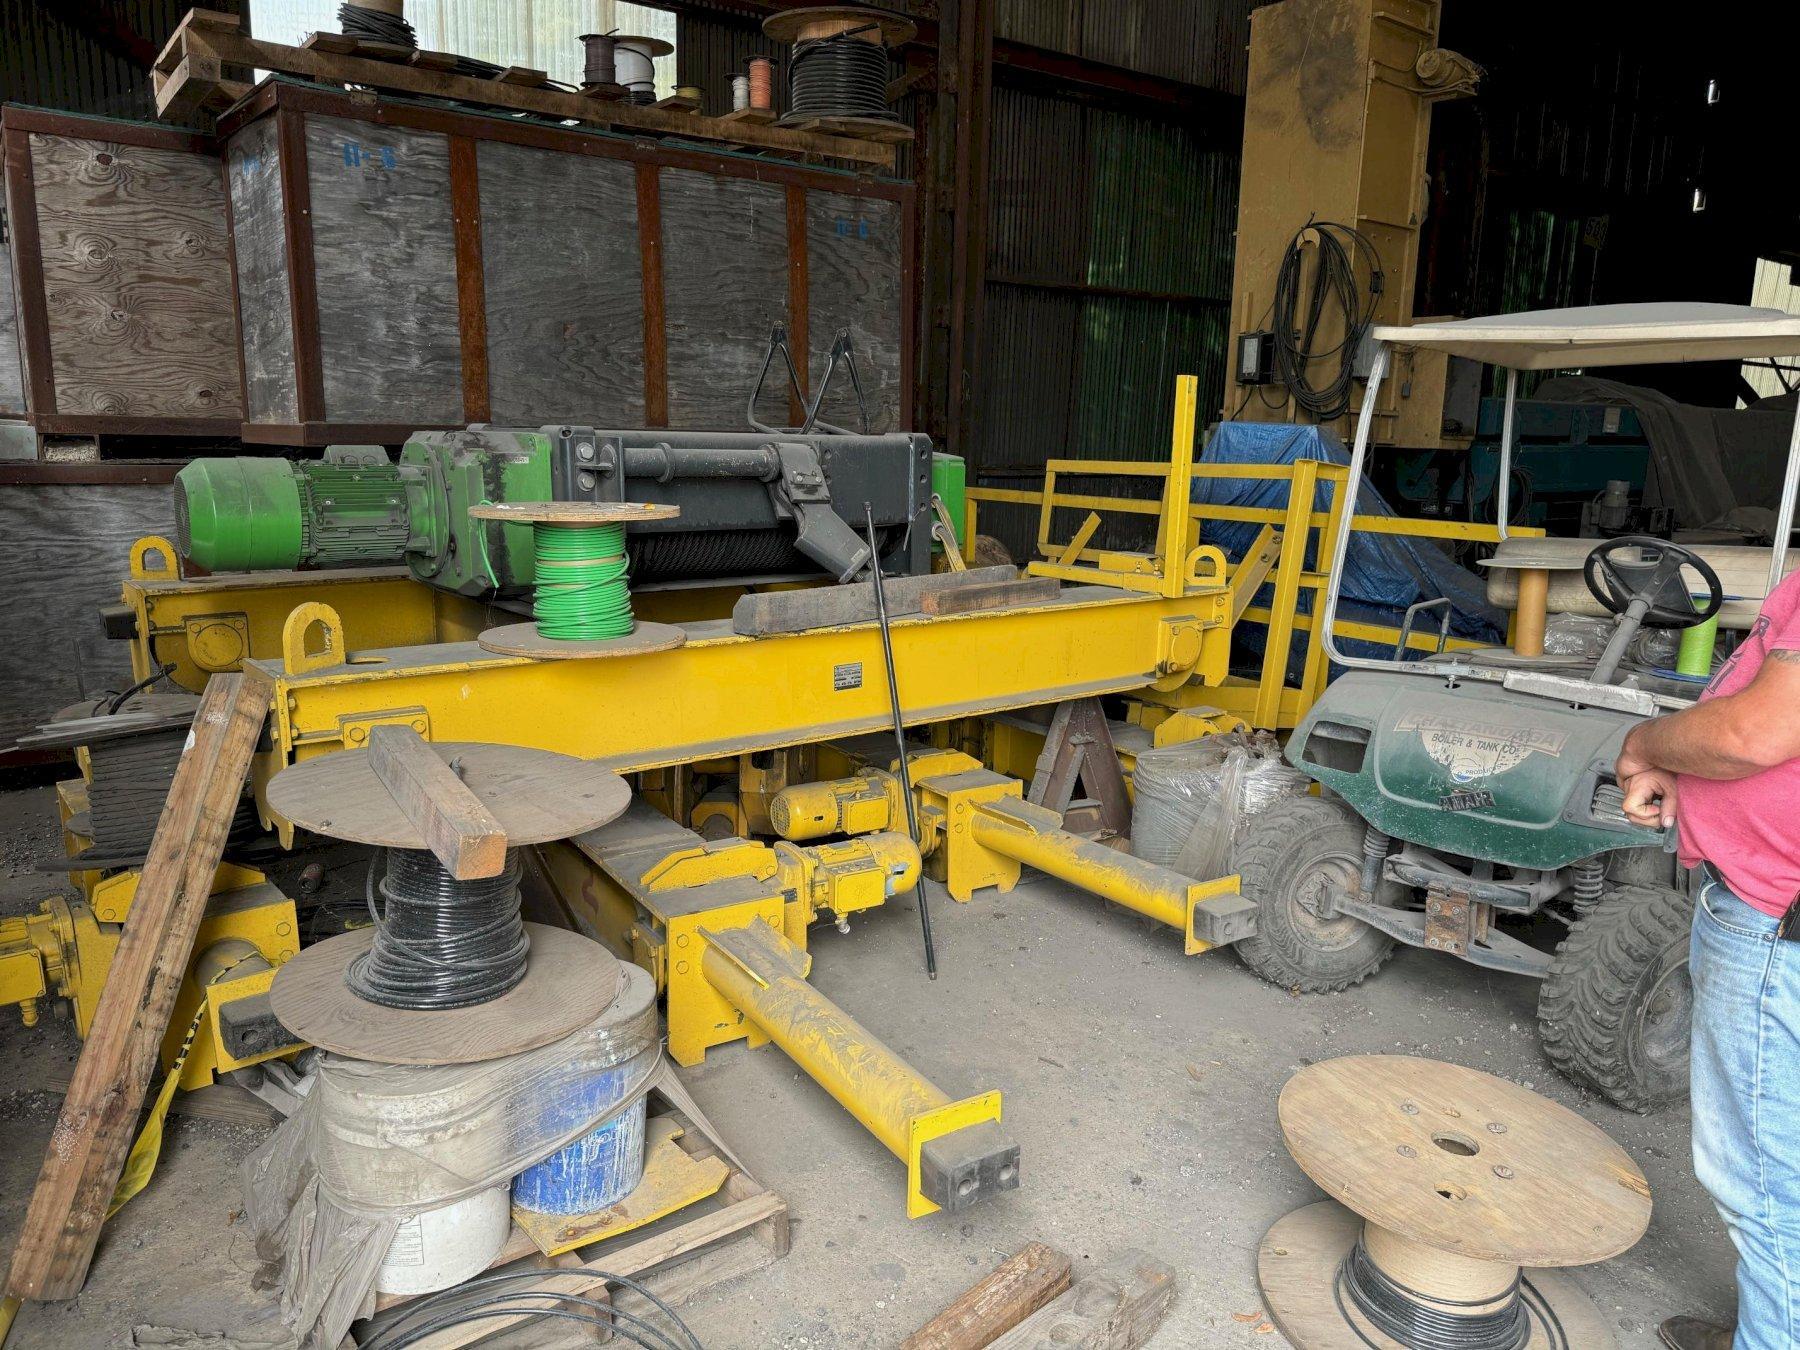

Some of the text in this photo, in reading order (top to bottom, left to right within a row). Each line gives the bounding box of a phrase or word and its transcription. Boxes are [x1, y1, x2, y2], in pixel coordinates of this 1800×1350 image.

[1431, 733, 1464, 747] BOILER
[1465, 739, 1473, 748] &
[1477, 739, 1500, 752] TANK
